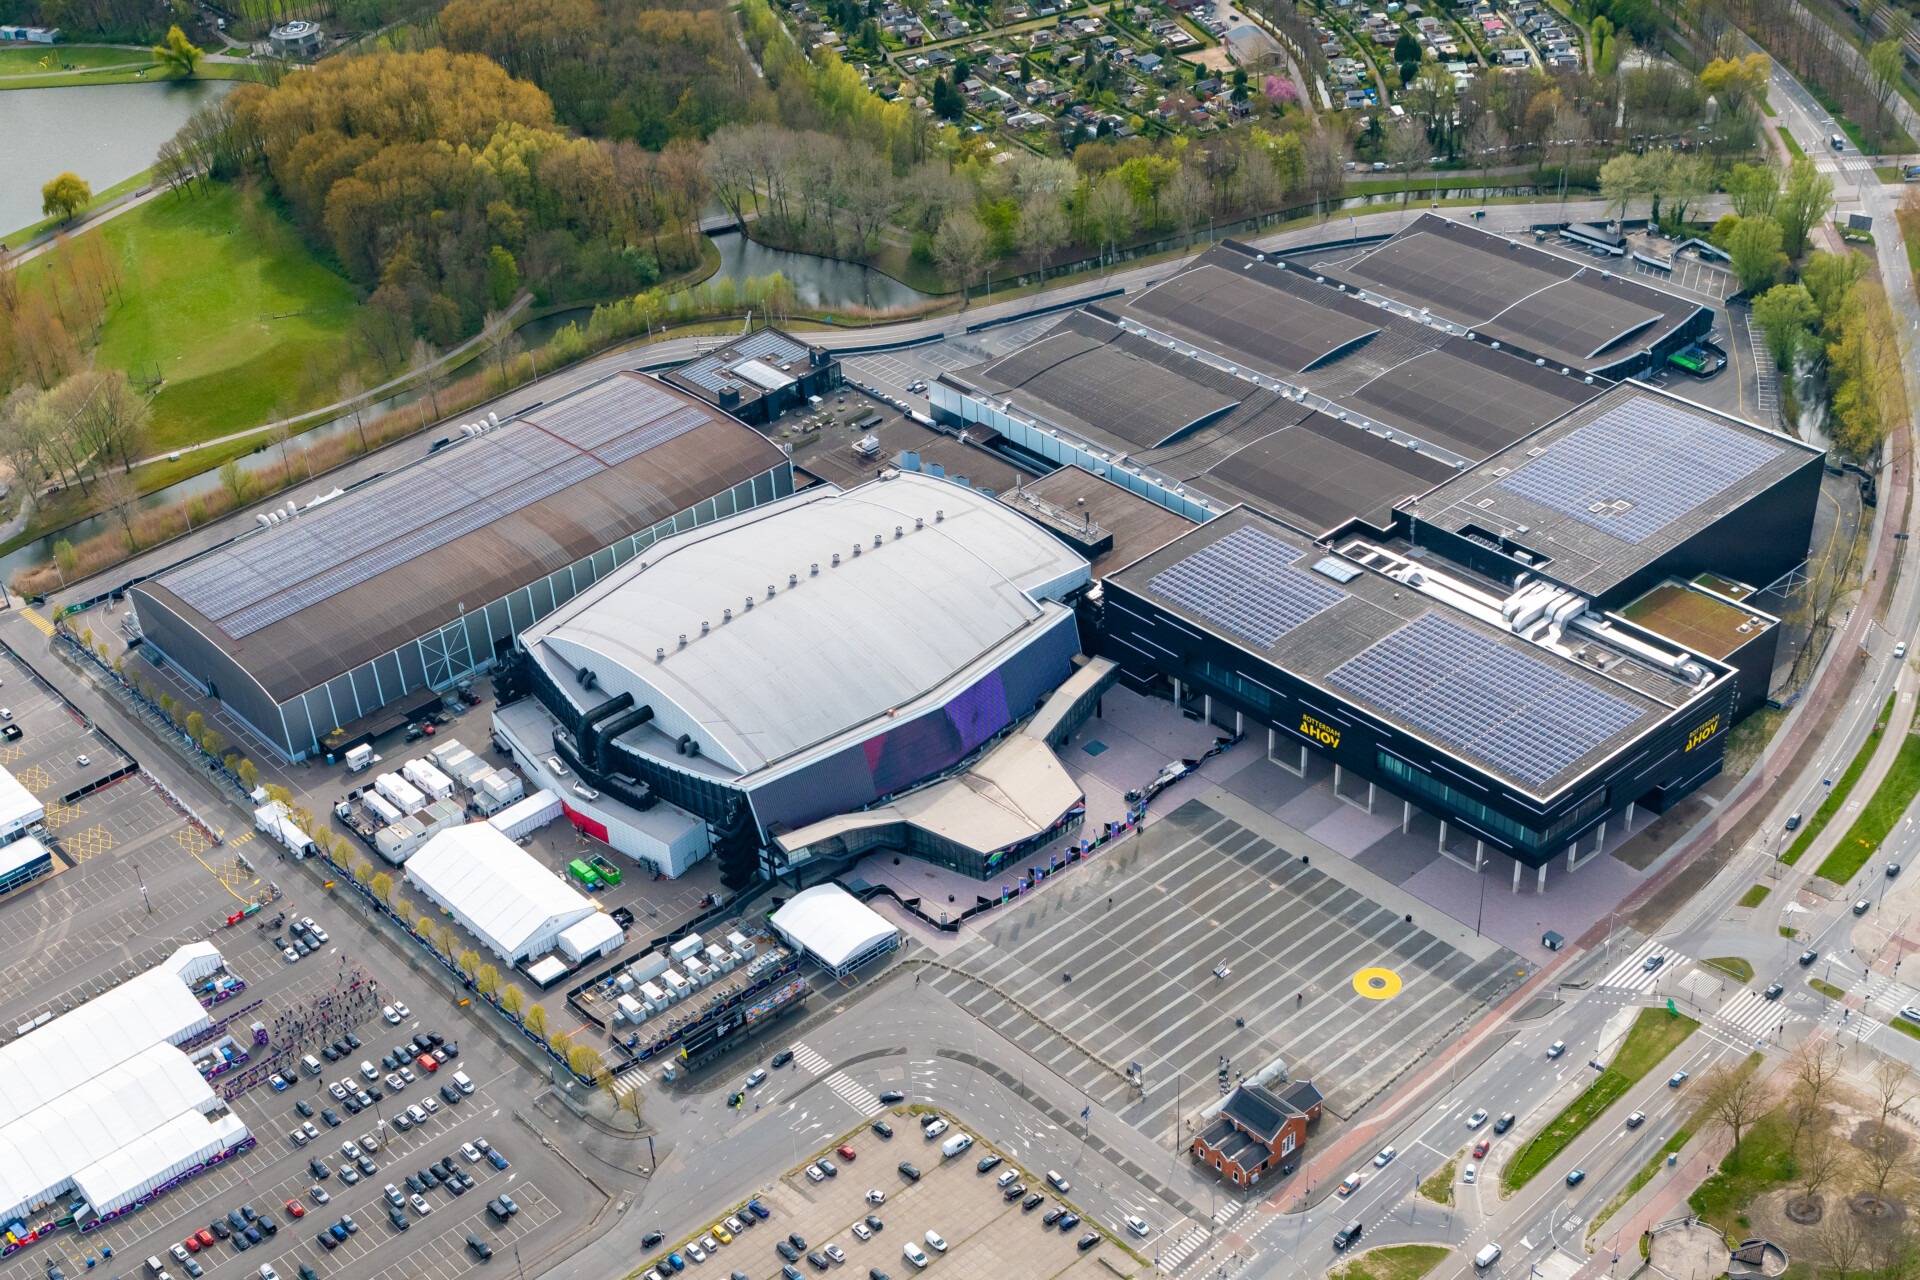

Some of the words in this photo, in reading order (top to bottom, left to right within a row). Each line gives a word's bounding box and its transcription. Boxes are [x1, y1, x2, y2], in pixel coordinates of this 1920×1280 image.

[1300, 721, 1340, 748] AHOY
[1302, 714, 1340, 738] ROTTERDAM
[1685, 721, 1718, 752] AHOY
